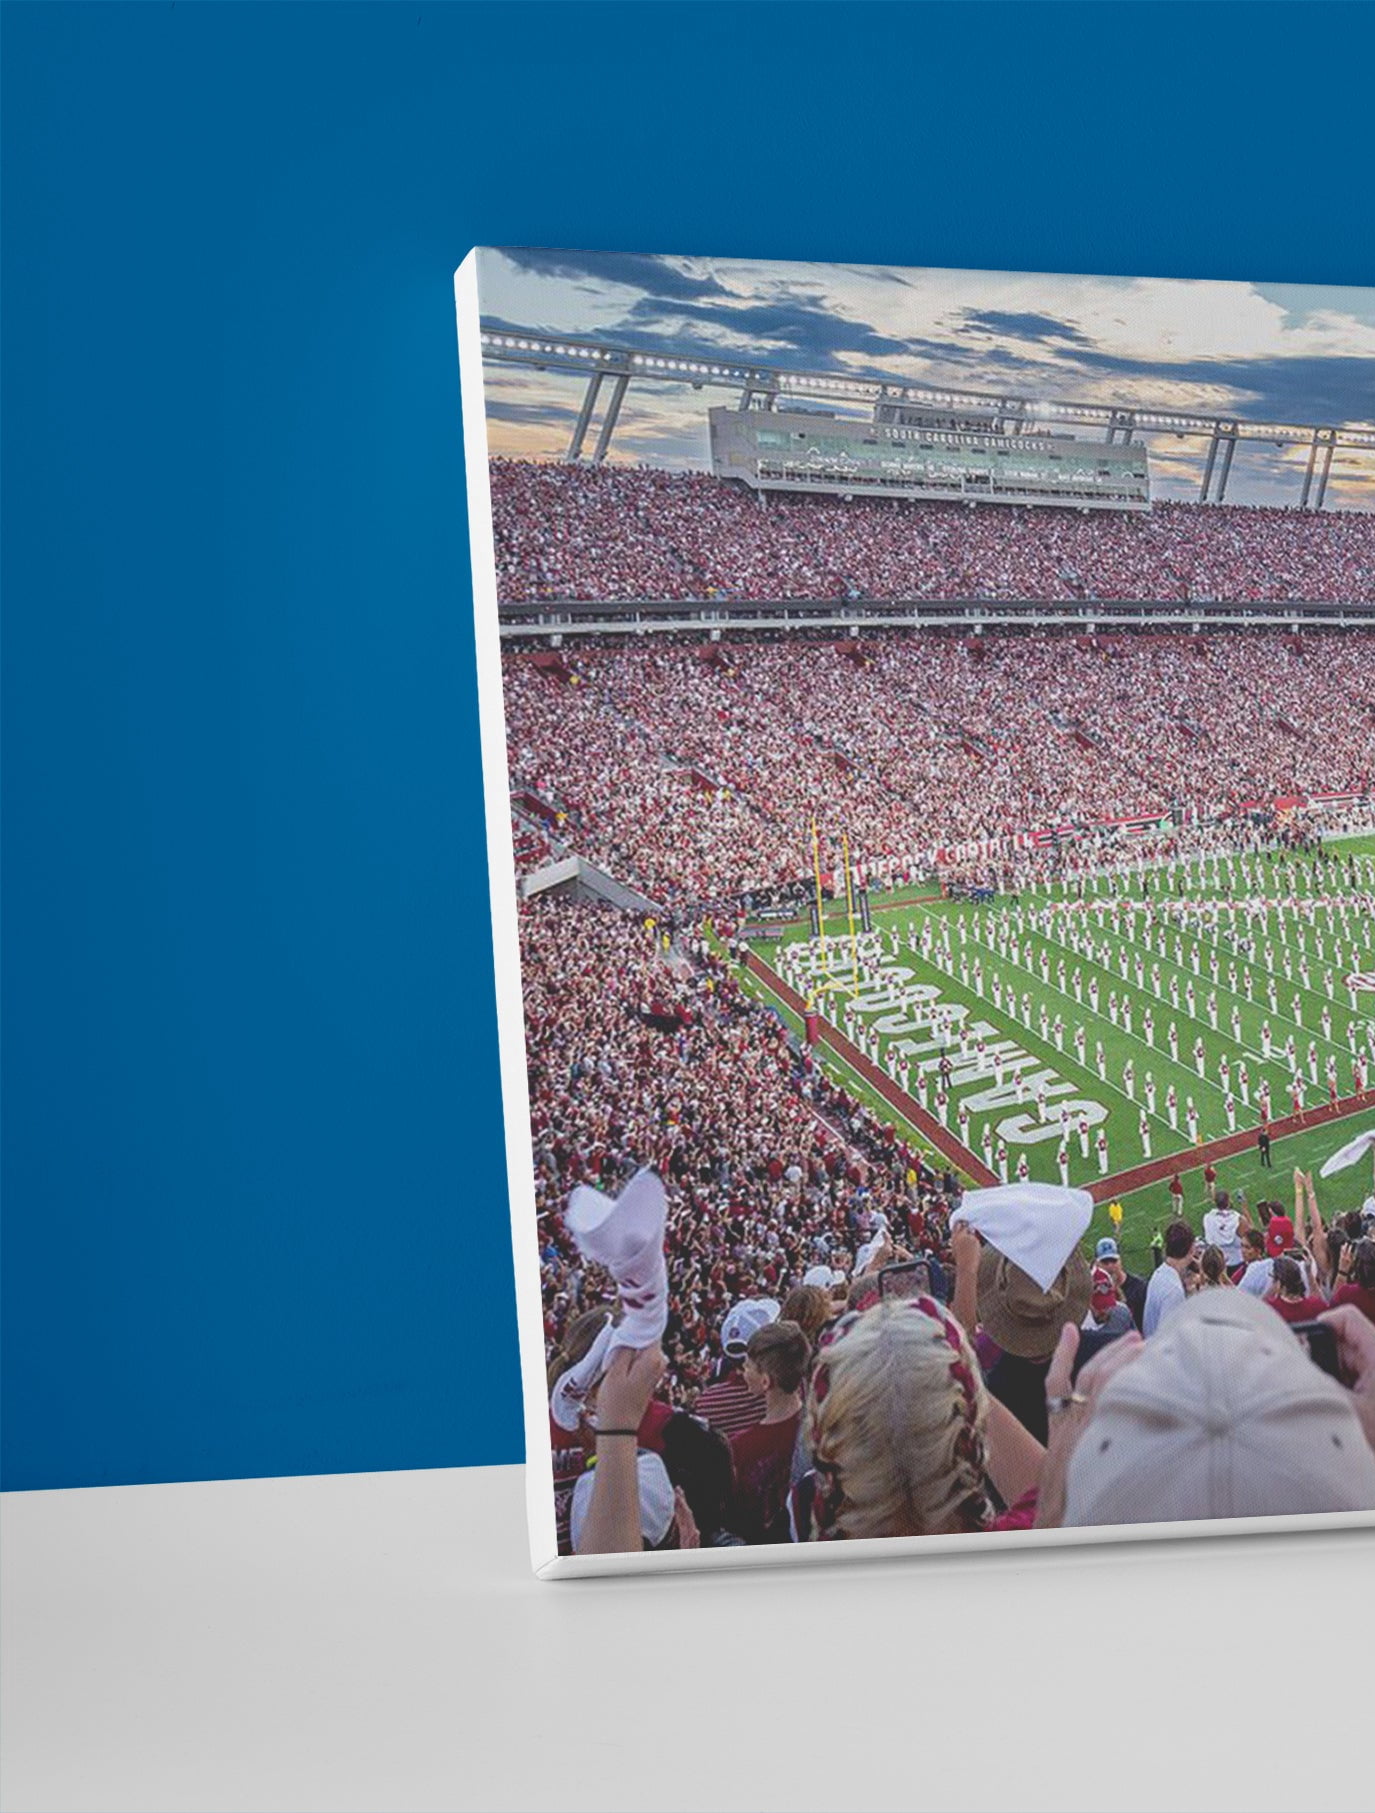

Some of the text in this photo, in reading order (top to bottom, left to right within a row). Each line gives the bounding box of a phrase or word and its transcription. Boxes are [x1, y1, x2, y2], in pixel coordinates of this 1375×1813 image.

[884, 427, 1045, 451] SOUTH CAROLINA GAMECOCKS
